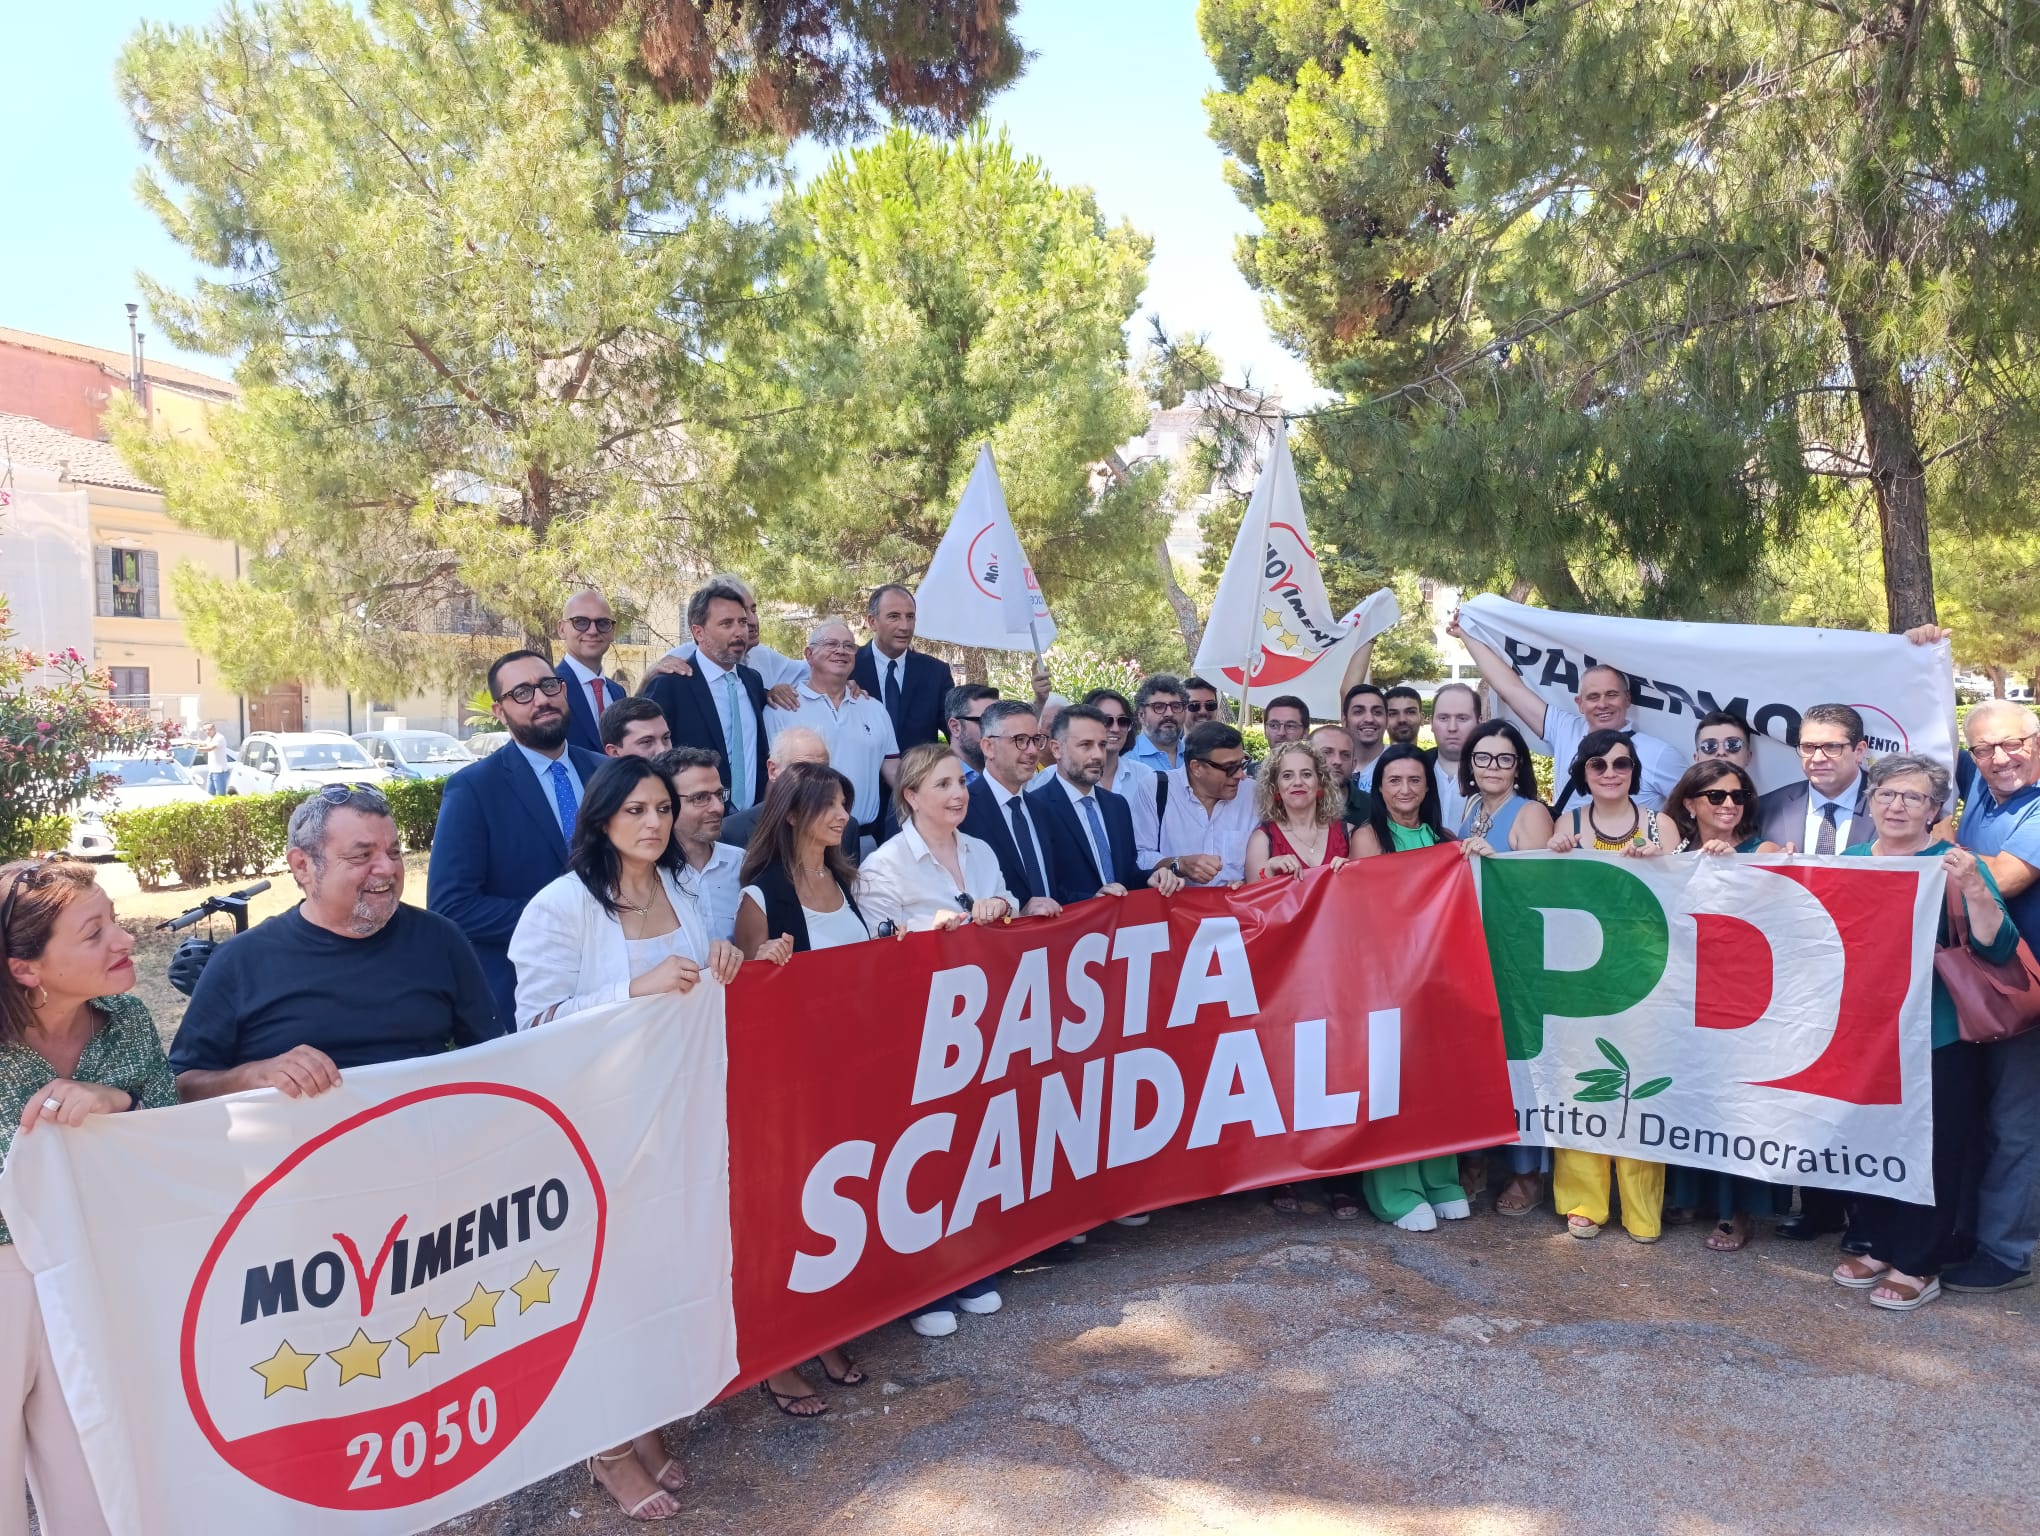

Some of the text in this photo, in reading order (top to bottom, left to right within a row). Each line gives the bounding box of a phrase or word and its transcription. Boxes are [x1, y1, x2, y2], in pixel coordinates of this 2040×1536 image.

[1505, 636, 1802, 747] PAERMO
[911, 917, 1260, 1106] BASTA
[1481, 858, 1897, 1103] PD
[787, 1007, 1401, 1294] SCANDALI
[1640, 1113, 1906, 1183] Democratico
[241, 1178, 570, 1325] MOVIMENTO
[347, 1386, 498, 1492] 2050
